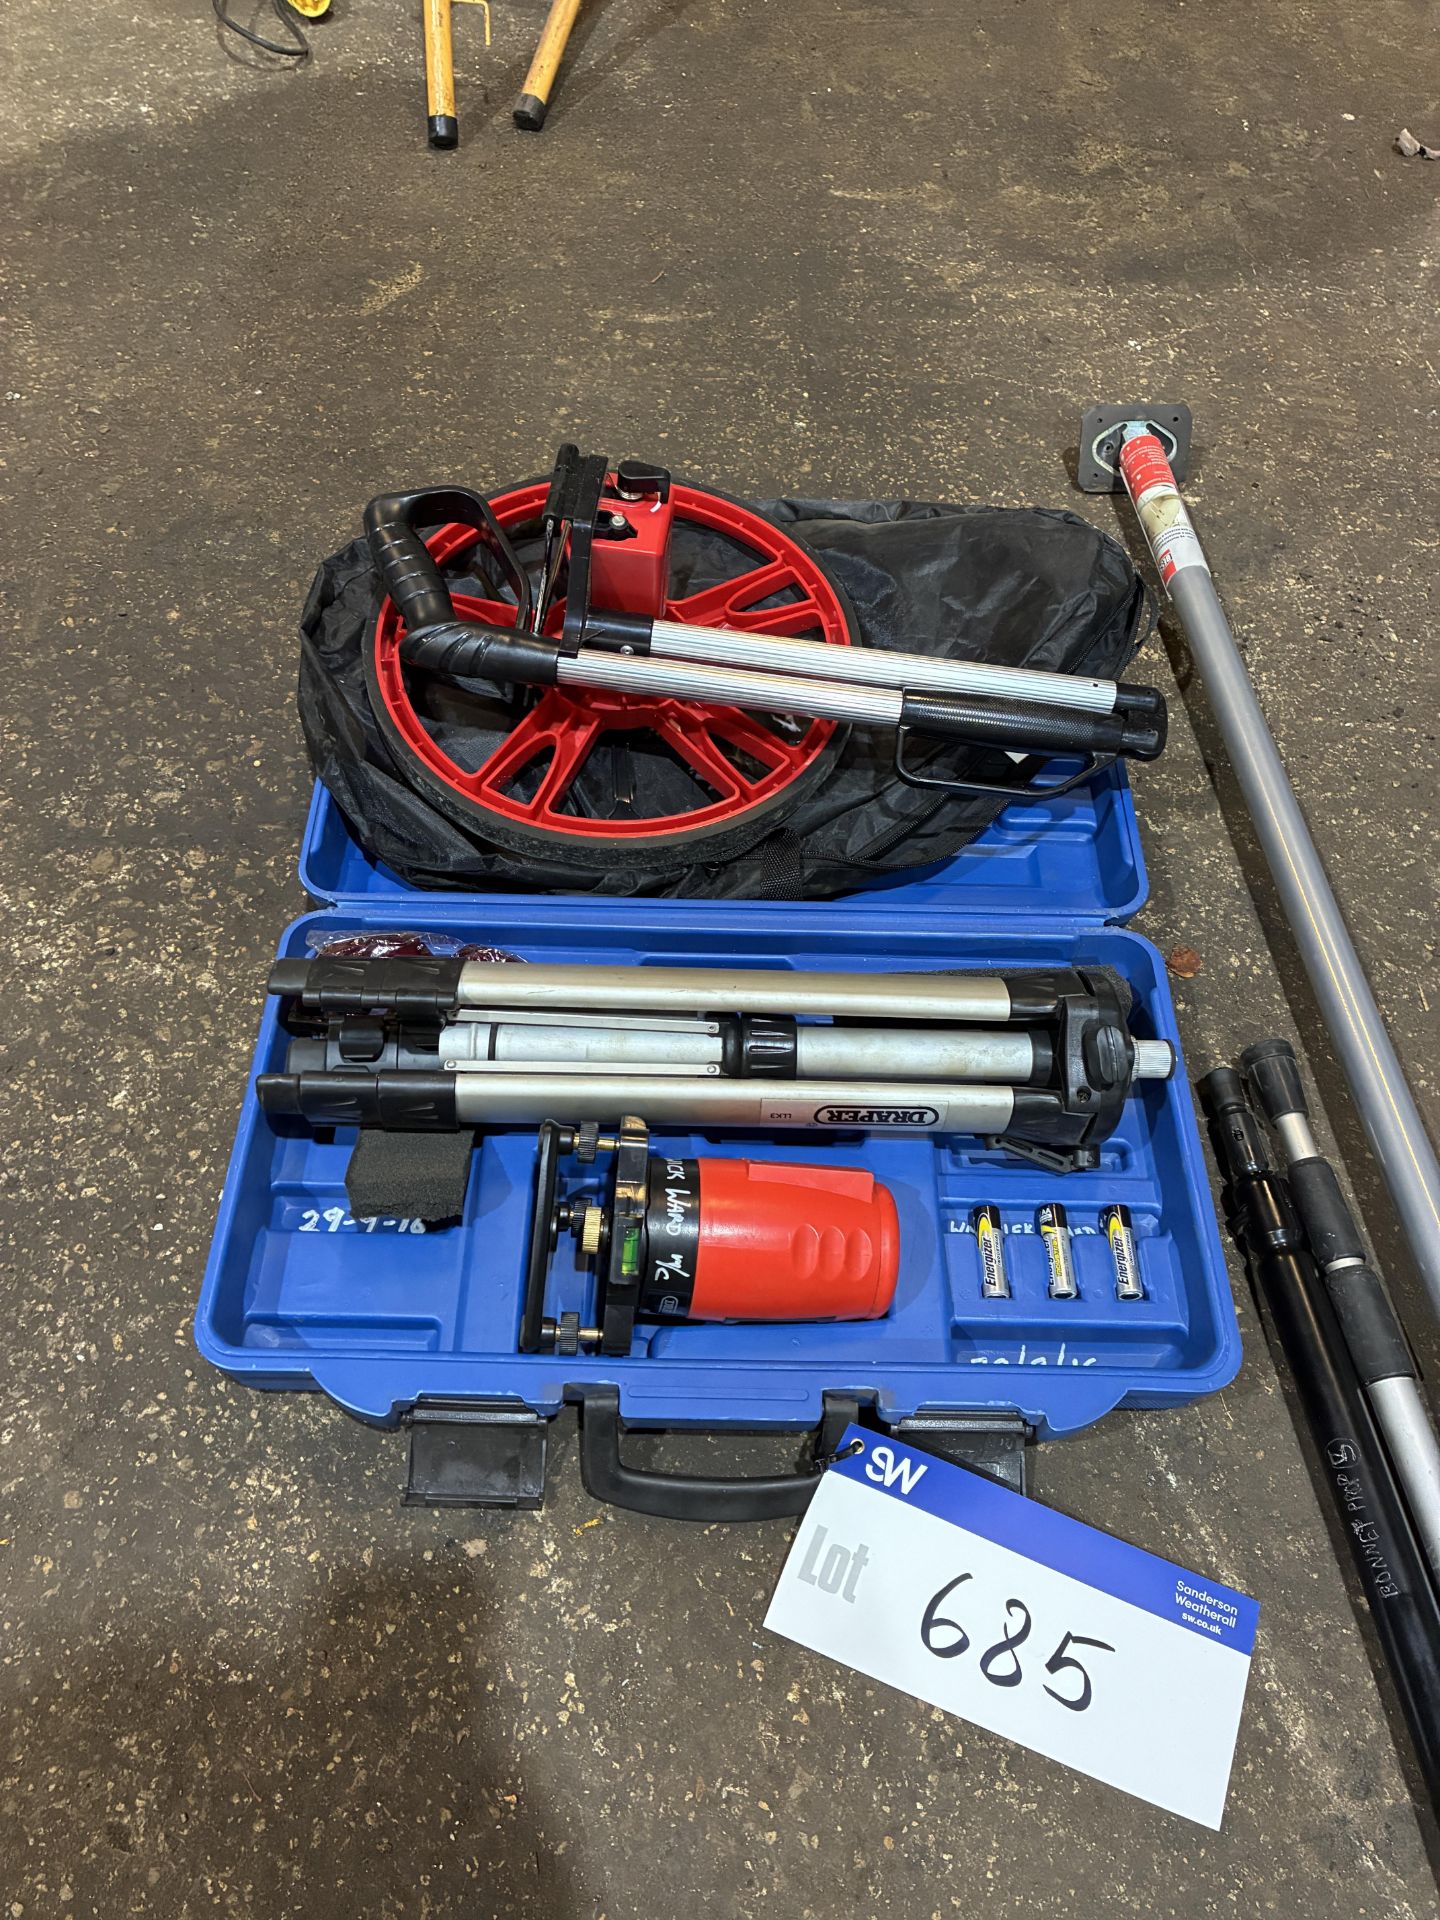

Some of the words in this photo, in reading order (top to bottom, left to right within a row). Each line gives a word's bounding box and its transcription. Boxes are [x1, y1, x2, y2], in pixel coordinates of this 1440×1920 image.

[826, 1109, 928, 1123] DRAPER
[664, 1187, 692, 1236] WARD
[983, 1236, 997, 1287] Energizer
[1113, 1236, 1130, 1285] Energizer
[865, 1446, 928, 1495] SW
[796, 1524, 870, 1604] Lot
[1175, 1592, 1237, 1629] Weatherall
[1176, 1580, 1238, 1616] Sanderson
[920, 1572, 1116, 1712] 685
[1181, 1612, 1222, 1636] sw.co.uk
